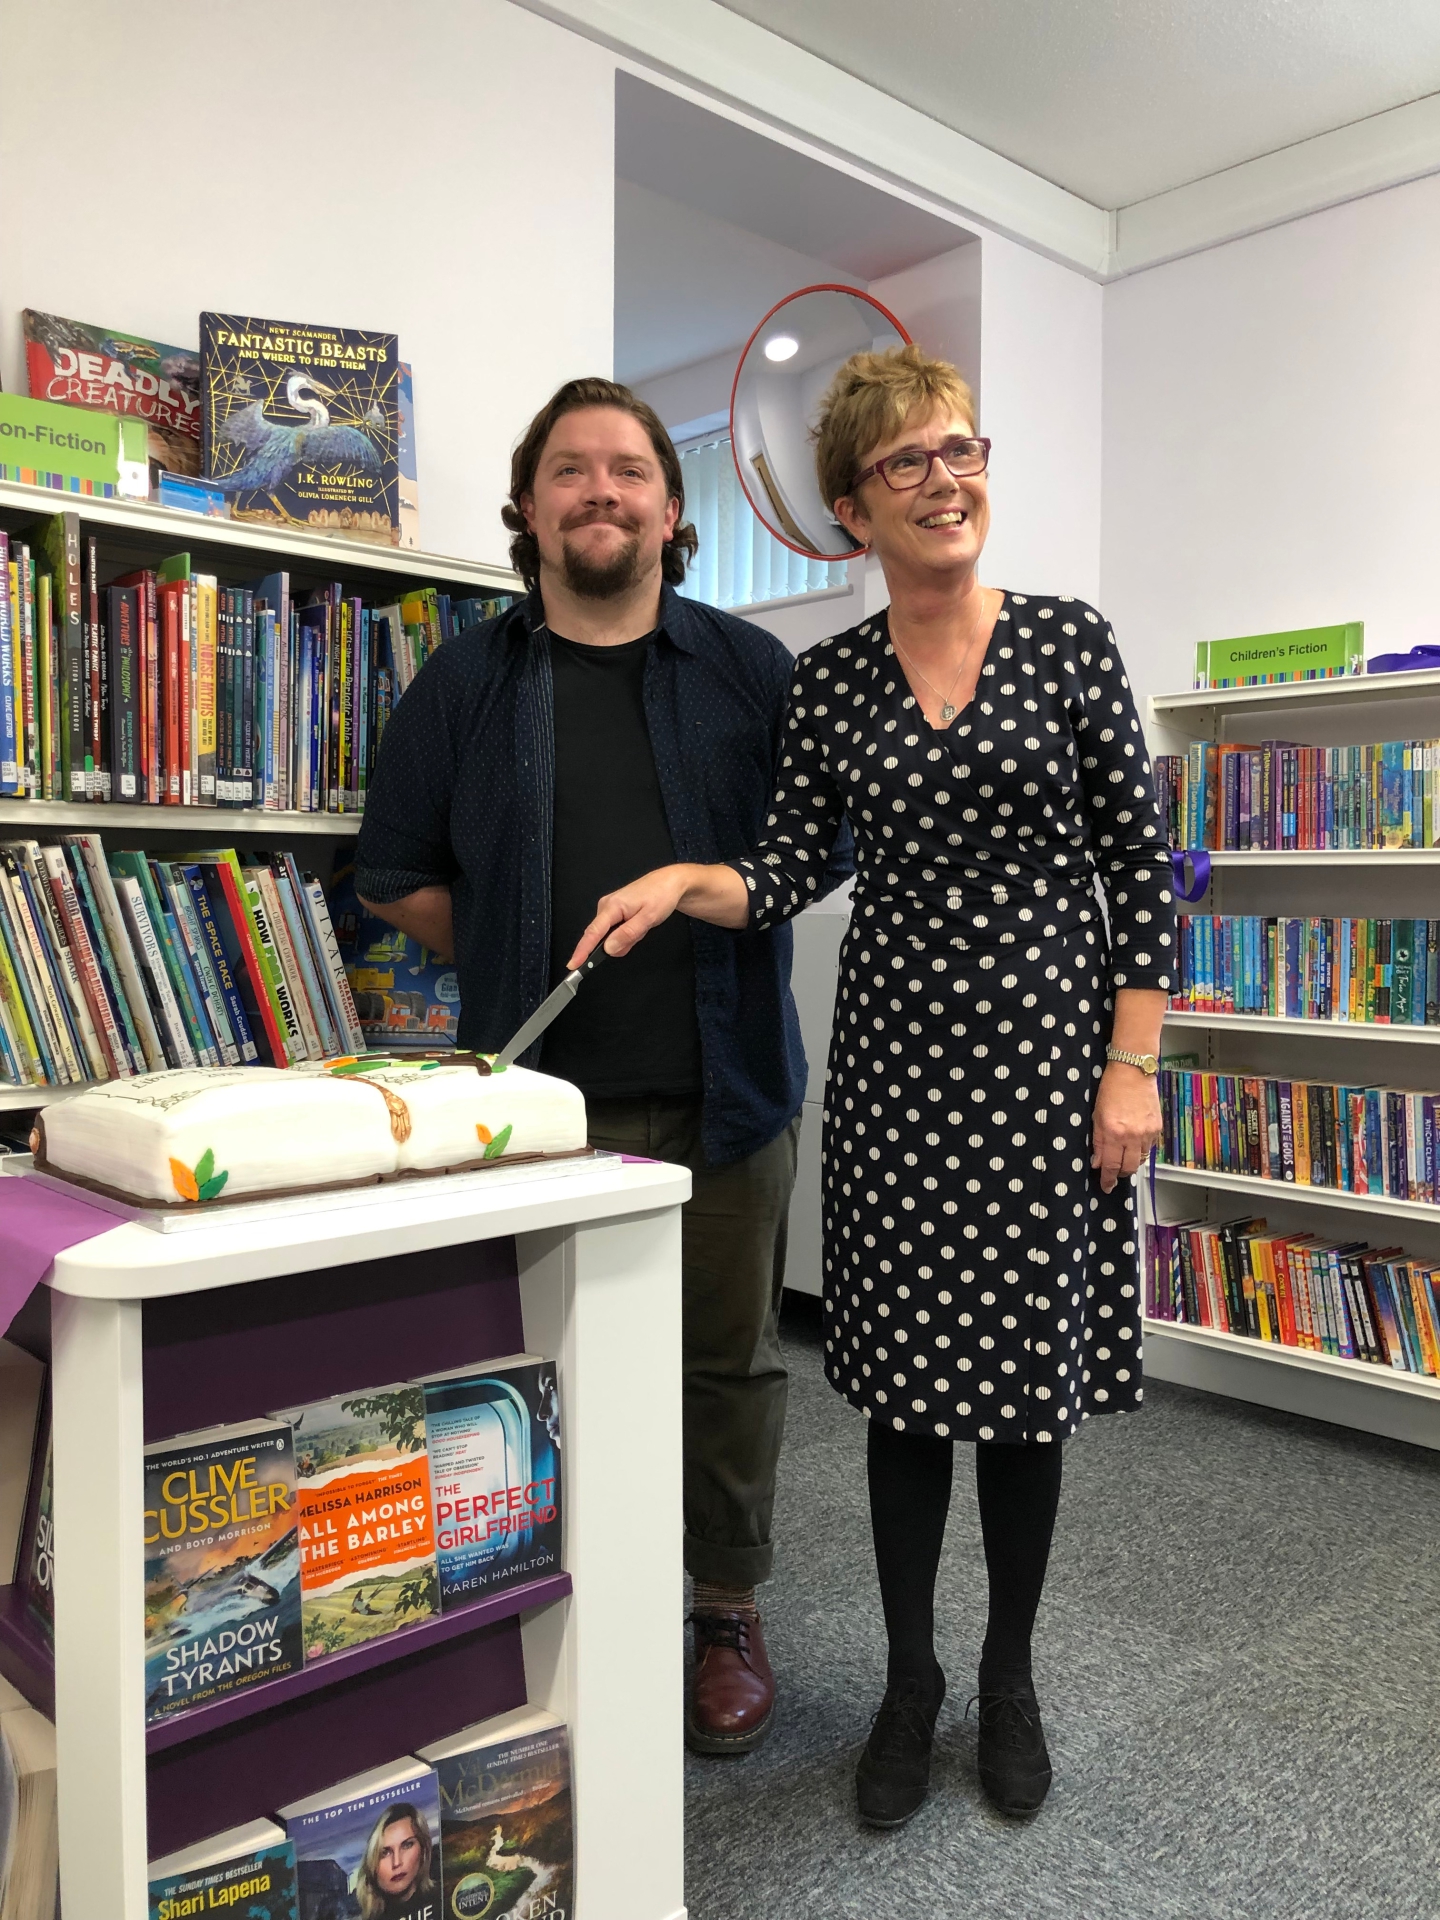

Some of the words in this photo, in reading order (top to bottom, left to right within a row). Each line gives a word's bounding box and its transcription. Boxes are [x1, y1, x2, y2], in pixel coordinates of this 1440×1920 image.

[217, 330, 314, 355] FANTASTIC
[321, 343, 388, 363] BEASTS
[269, 326, 289, 336] NEWT
[292, 329, 337, 341] SCAMANDER
[238, 350, 259, 359] AND
[262, 352, 296, 363] WHERE
[298, 355, 311, 365] TO
[314, 357, 337, 368] FIND
[339, 360, 366, 371] THEM
[54, 347, 200, 415] DEADLY
[45, 376, 200, 440] CREATURES
[297, 491, 319, 500] OLIVIA
[321, 493, 356, 503] LOMENECH
[358, 496, 374, 504] GILL
[298, 472, 319, 485] J.K.
[321, 475, 373, 489] ROWLING
[67, 533, 80, 626] HOLES
[0, 600, 12, 643] WORLD
[91, 623, 99, 648] PLASTIC
[121, 601, 130, 646] ADVENTURES
[1, 644, 13, 687] WORKS
[200, 643, 214, 680] NORSE
[333, 663, 341, 680] TIME
[1229, 647, 1285, 663] Children's
[1288, 642, 1328, 656] Fiction
[120, 655, 132, 699] PHILOSOPHY
[344, 677, 354, 716] Periodic
[4, 695, 12, 711] CLIVE
[199, 681, 214, 718] MYTHS
[5, 711, 13, 739] GIFFORD
[344, 717, 353, 741] Table
[37, 861, 54, 905] EYEWITNESS
[55, 919, 67, 946] GUIDES
[185, 905, 196, 927] BRIGHT
[20, 902, 34, 930] KILLER
[29, 931, 43, 959] WHALE
[73, 917, 94, 963] INVENTIONS
[131, 896, 158, 958] SURVIVORS
[190, 927, 204, 951] SPARKS
[197, 894, 211, 918] THE
[205, 920, 223, 958] SPACE
[217, 959, 233, 990] RACE
[246, 933, 258, 960] CURIOSITY
[314, 899, 345, 980] PIXAR
[64, 950, 80, 984] SHARK
[89, 963, 97, 979] AND
[98, 928, 109, 955] MEDICAL
[105, 955, 123, 996] TECHNOLOGY
[253, 909, 271, 944] HOW
[276, 985, 299, 1038] WORKS
[200, 974, 209, 993] Travel
[341, 978, 360, 1029] CHARACTER
[47, 984, 55, 1000] Mark
[51, 999, 63, 1029] Carwardine
[92, 978, 115, 1032] DISCOVERIES
[229, 995, 240, 1016] Sarah
[235, 1015, 249, 1044] Cruddas
[336, 980, 354, 1032] ENCYCLOPEDIA
[1250, 1109, 1258, 1136] SECRET
[1280, 1096, 1291, 1135] AGAINST
[1425, 1118, 1433, 1146] ATTICUS
[1282, 1141, 1294, 1166] GODS
[1284, 1134, 1292, 1142] ALL
[145, 1463, 160, 1471] THE
[162, 1457, 192, 1468] WORLD'S
[193, 1453, 209, 1463] NO.1
[211, 1445, 249, 1459] ADVENTURE
[251, 1440, 275, 1450] WRITER
[162, 1456, 258, 1505] CLIVE
[299, 1497, 352, 1518] MELISSA
[355, 1477, 422, 1504] HARRISON
[435, 1482, 462, 1497] THE
[144, 1482, 291, 1544] CUSSLER
[300, 1518, 338, 1542] ALL
[346, 1495, 425, 1530] AMONG
[436, 1477, 556, 1527] PERFECT
[159, 1545, 182, 1556] AND
[186, 1536, 214, 1549] BOYD
[218, 1522, 271, 1542] MORRISON
[301, 1538, 339, 1563] THE
[347, 1514, 427, 1551] BARLEY
[437, 1504, 558, 1550] GIRLFRIEND
[441, 1558, 453, 1566] ALL
[454, 1554, 467, 1563] SHE
[467, 1547, 495, 1560] WANTED
[495, 1543, 509, 1551] WAS
[451, 1563, 464, 1571] GET
[465, 1560, 477, 1568] HIM
[477, 1554, 495, 1565] BACK
[442, 1574, 488, 1596] KAREN
[492, 1554, 554, 1581] HAMILTON
[166, 1615, 279, 1671] SHADOW
[161, 1638, 282, 1697] TYRANTS
[162, 1697, 190, 1712] NOVEL
[192, 1688, 216, 1702] FROM
[218, 1681, 233, 1692] THE
[235, 1668, 270, 1686] OREGON
[271, 1661, 292, 1675] FILES
[486, 1759, 509, 1769] SUNDAY
[510, 1752, 527, 1763] TIMES
[527, 1742, 560, 1758] BESTSELLER
[498, 1752, 509, 1760] THE
[510, 1744, 535, 1756] NUMBER
[536, 1740, 548, 1748] ONE
[440, 1750, 561, 1810] McDermid
[301, 1815, 320, 1826] THE
[324, 1807, 343, 1820] TOP
[347, 1801, 365, 1813] TEN
[369, 1781, 422, 1806] BESTSELLER
[157, 1890, 205, 1920] Shari
[208, 1873, 271, 1910] Lapena
[163, 1886, 177, 1897] THE
[178, 1879, 203, 1894] SUNDAY
[204, 1872, 224, 1886] TIMES
[225, 1860, 263, 1880] BESTSELLER
[458, 1893, 489, 1911] INTENT
